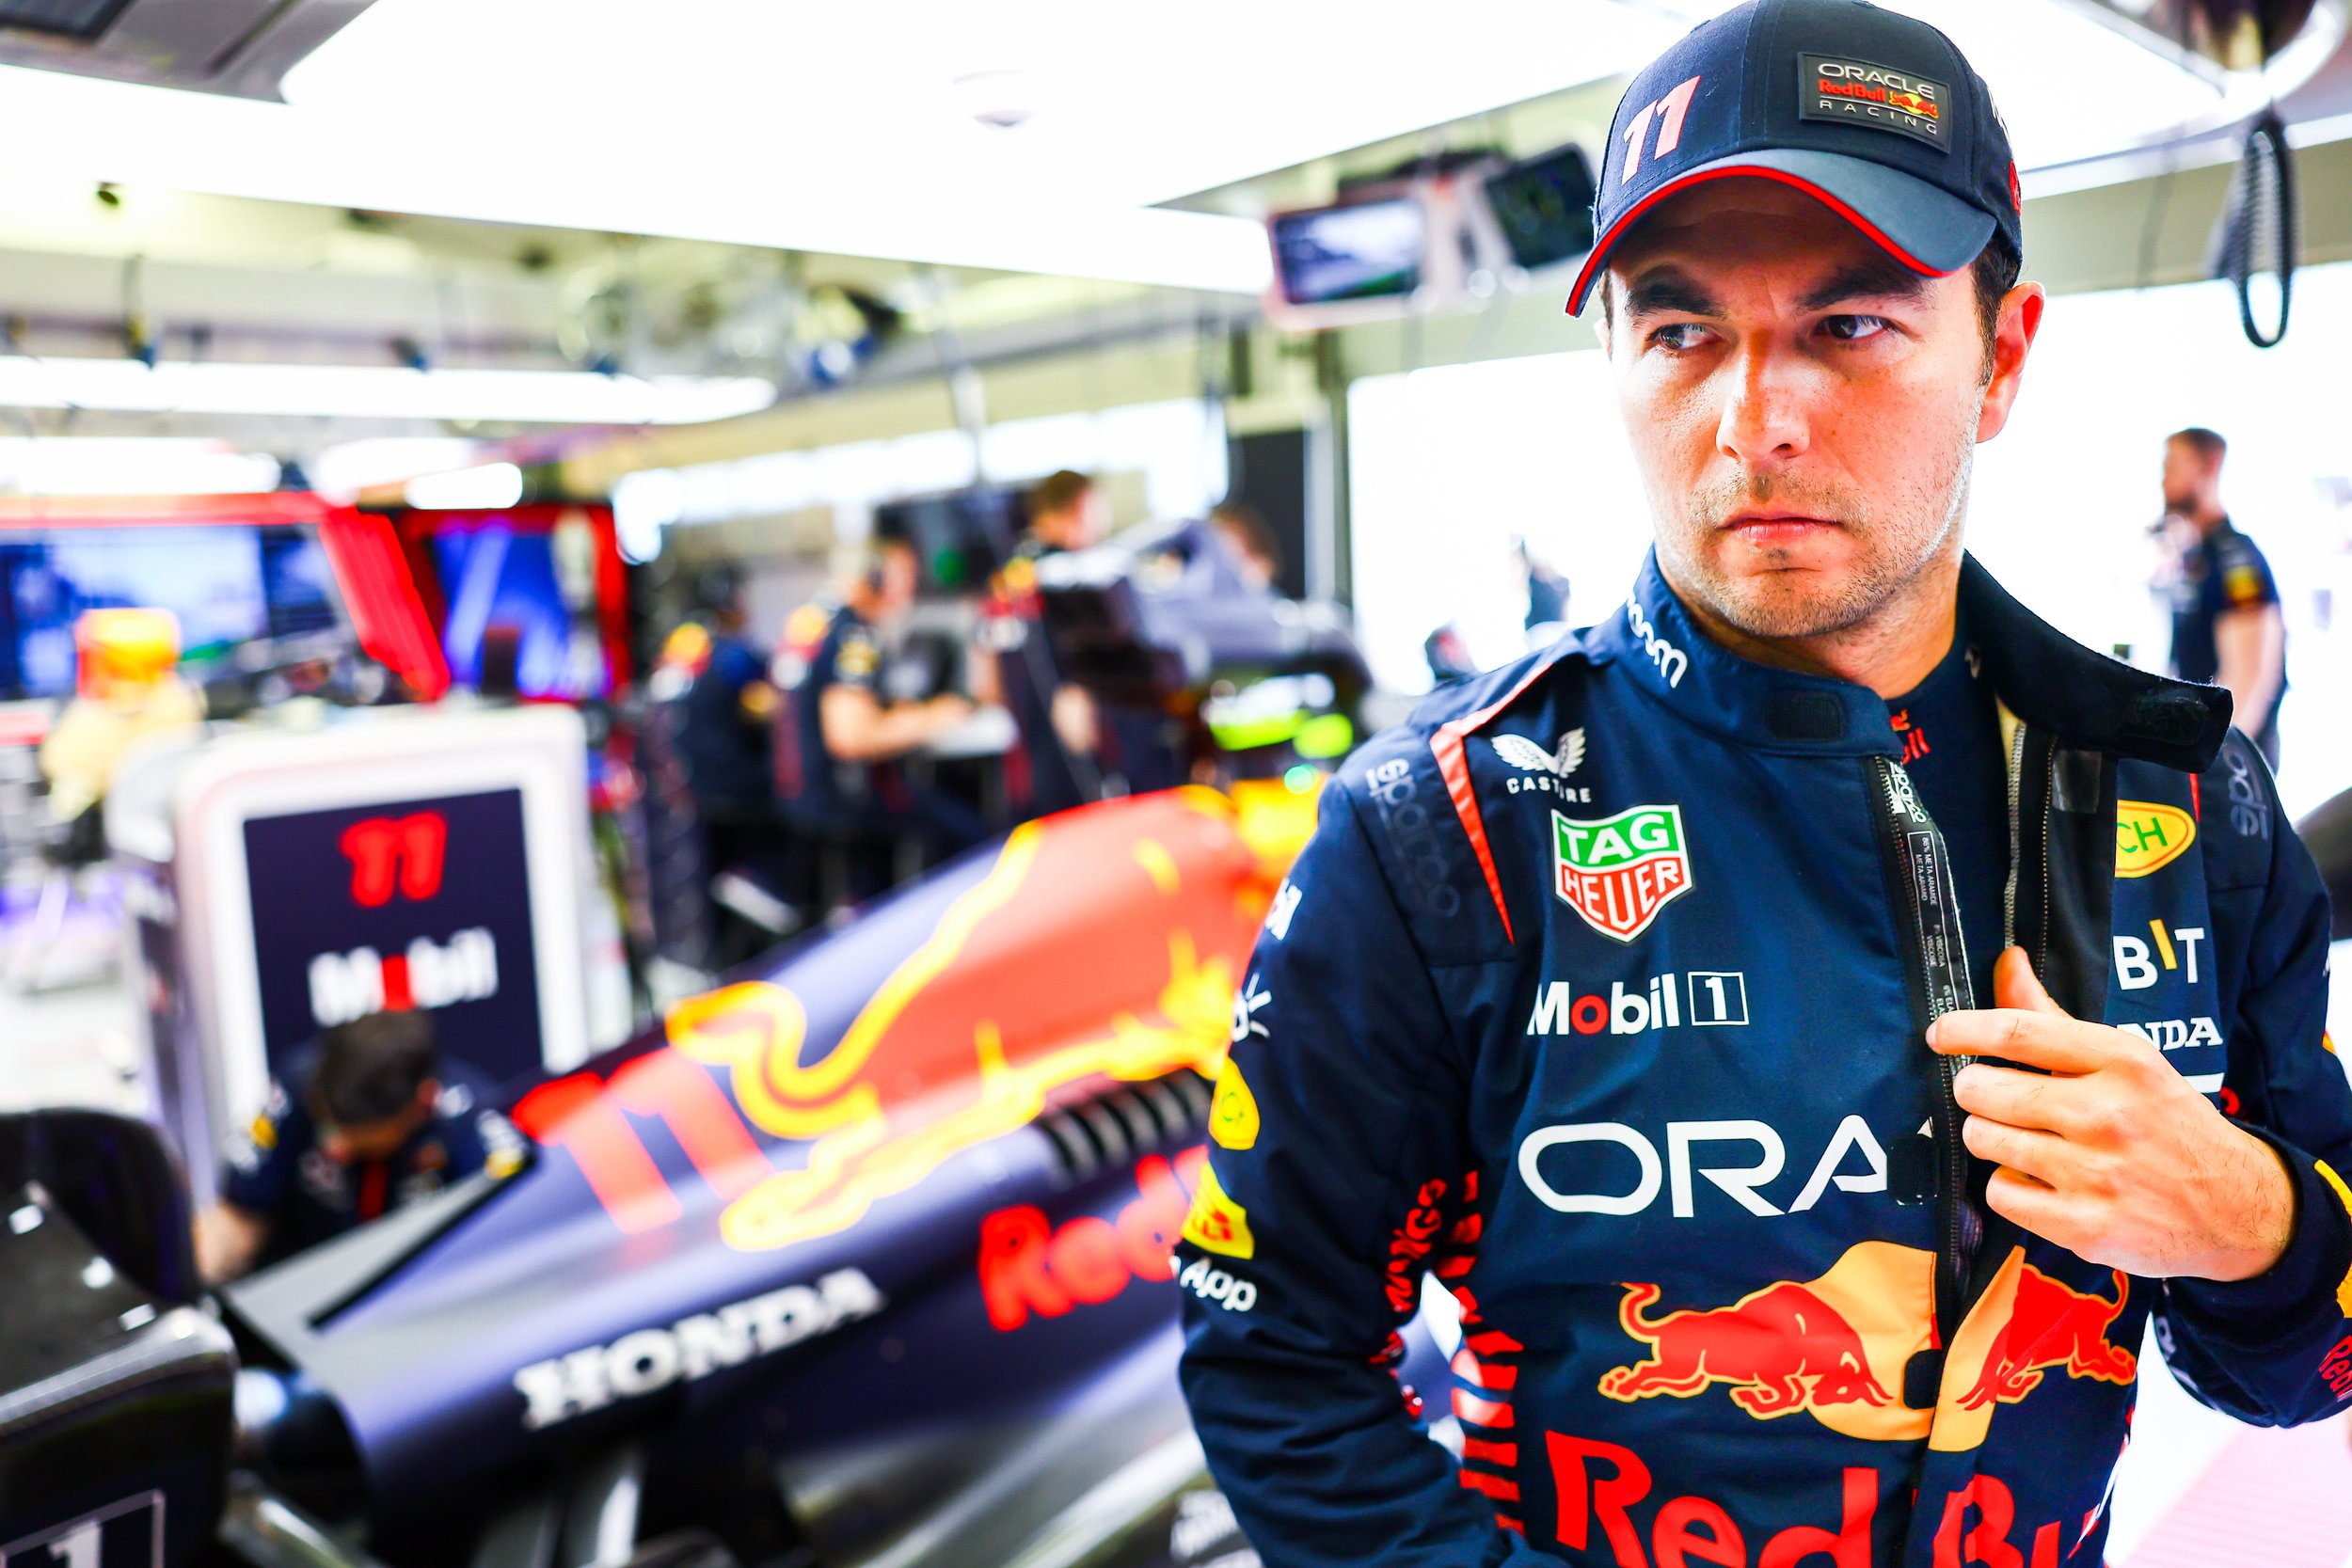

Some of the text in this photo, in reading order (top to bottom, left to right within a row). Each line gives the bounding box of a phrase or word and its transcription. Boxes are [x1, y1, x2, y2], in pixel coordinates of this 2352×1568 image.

[1818, 63, 1935, 101] ORACLE
[1819, 78, 1887, 103] Red Bull
[1621, 75, 1701, 186] 11
[1820, 100, 1938, 135] RACING
[1506, 779, 1592, 804] CASTRE
[339, 809, 448, 909] 11
[1561, 814, 1671, 864] TAG
[2116, 816, 2169, 853] CH
[1565, 860, 1681, 932] HEUER
[1526, 973, 1680, 1036] Mobil
[2117, 1016, 2223, 1052] NDA
[513, 1046, 779, 1235] 11
[1518, 1114, 1888, 1218] ORA
[1179, 1257, 1258, 1312] App
[513, 1268, 884, 1431] HONDA
[1546, 1429, 1879, 1568] Red
